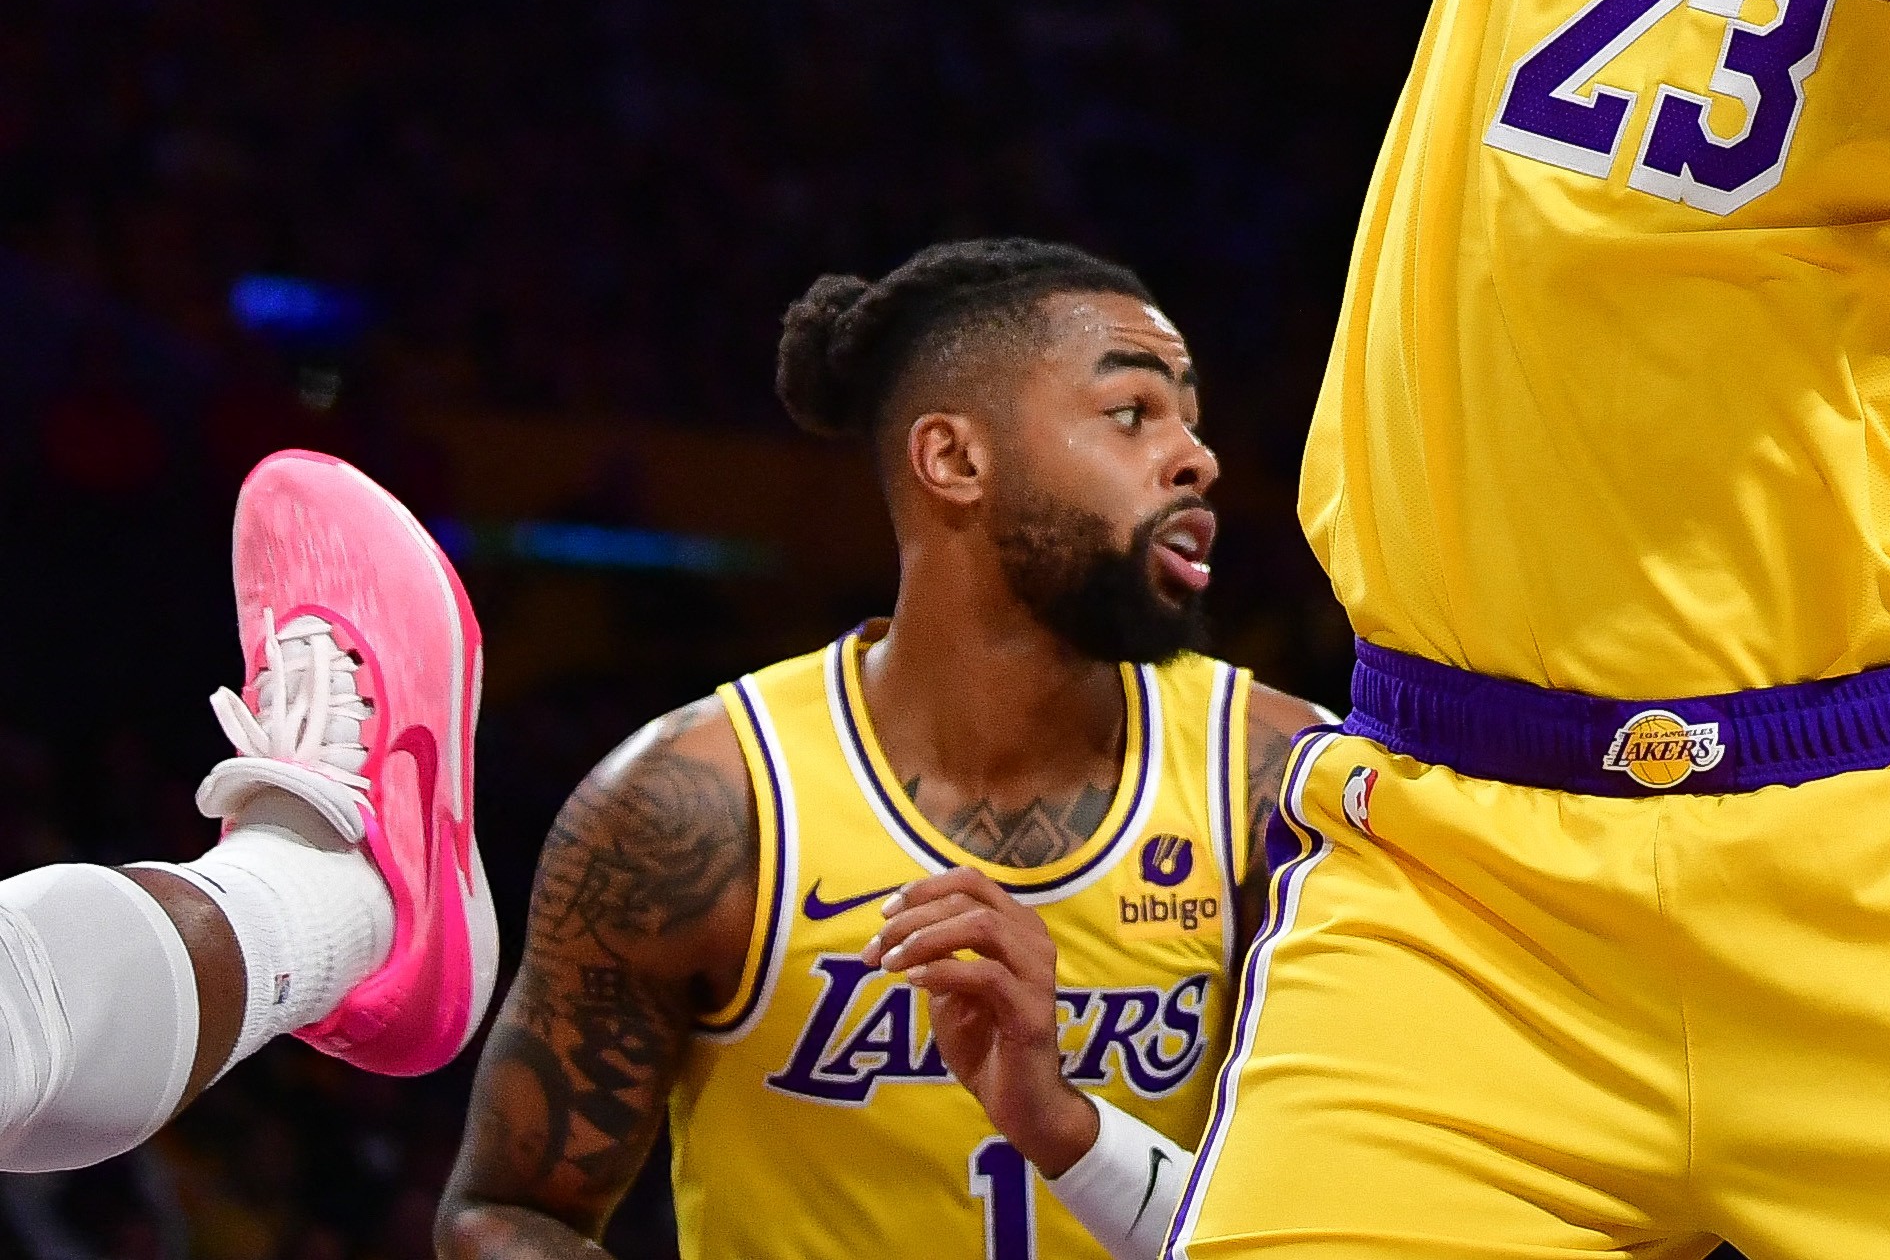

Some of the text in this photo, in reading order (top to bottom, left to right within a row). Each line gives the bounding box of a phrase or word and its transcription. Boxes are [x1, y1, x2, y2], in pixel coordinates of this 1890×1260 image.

[1606, 731, 1721, 768] LAKERS
[1119, 893, 1217, 931] bibigo
[970, 1137, 1037, 1260] 1
